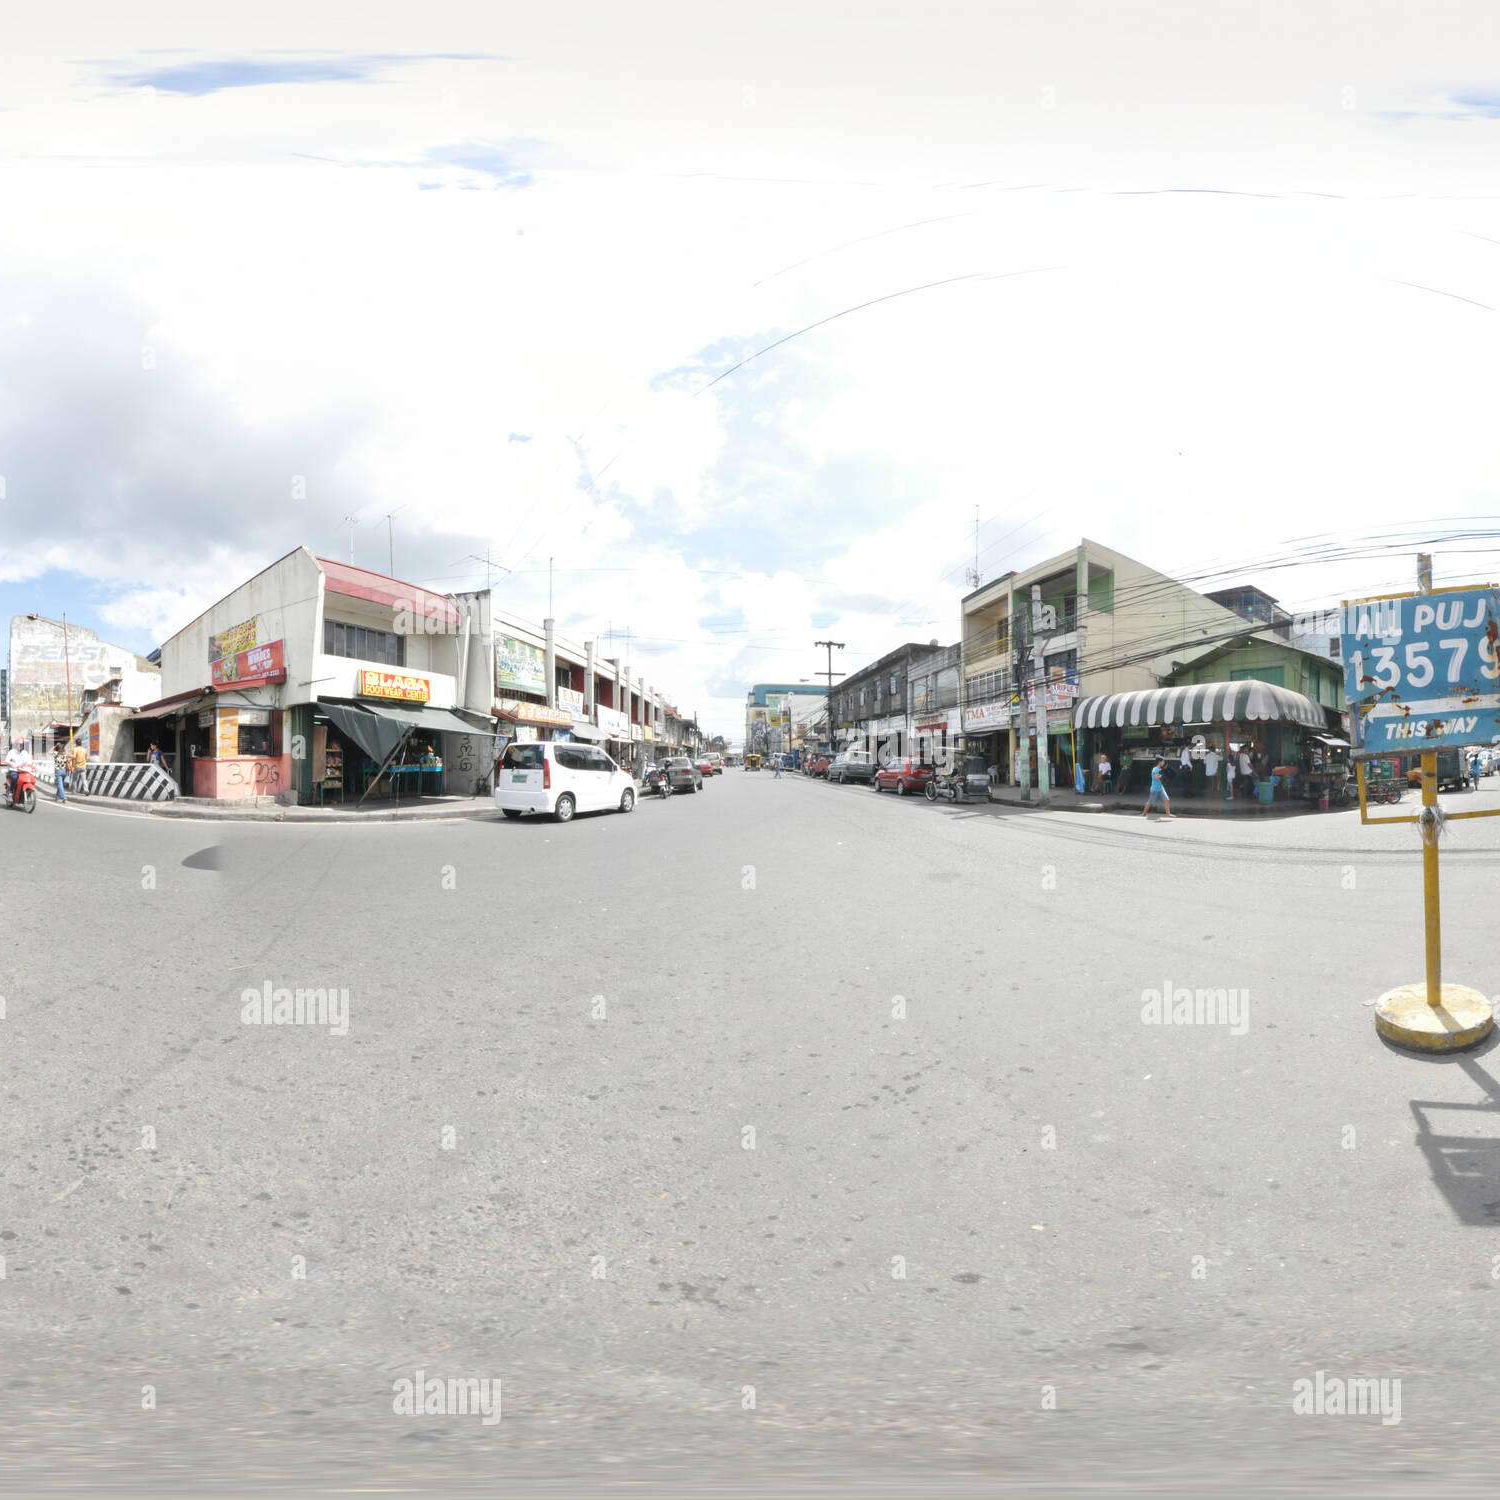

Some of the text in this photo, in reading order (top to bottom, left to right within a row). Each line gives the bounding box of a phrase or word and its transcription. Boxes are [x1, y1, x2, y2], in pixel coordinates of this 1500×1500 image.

[1356, 598, 1486, 641] ALL PUJ
[22, 645, 108, 661] PEPSI
[366, 684, 428, 700] FOOTWEAR CENTER
[966, 709, 985, 721] TMA
[1385, 716, 1478, 740] THIS WAY
